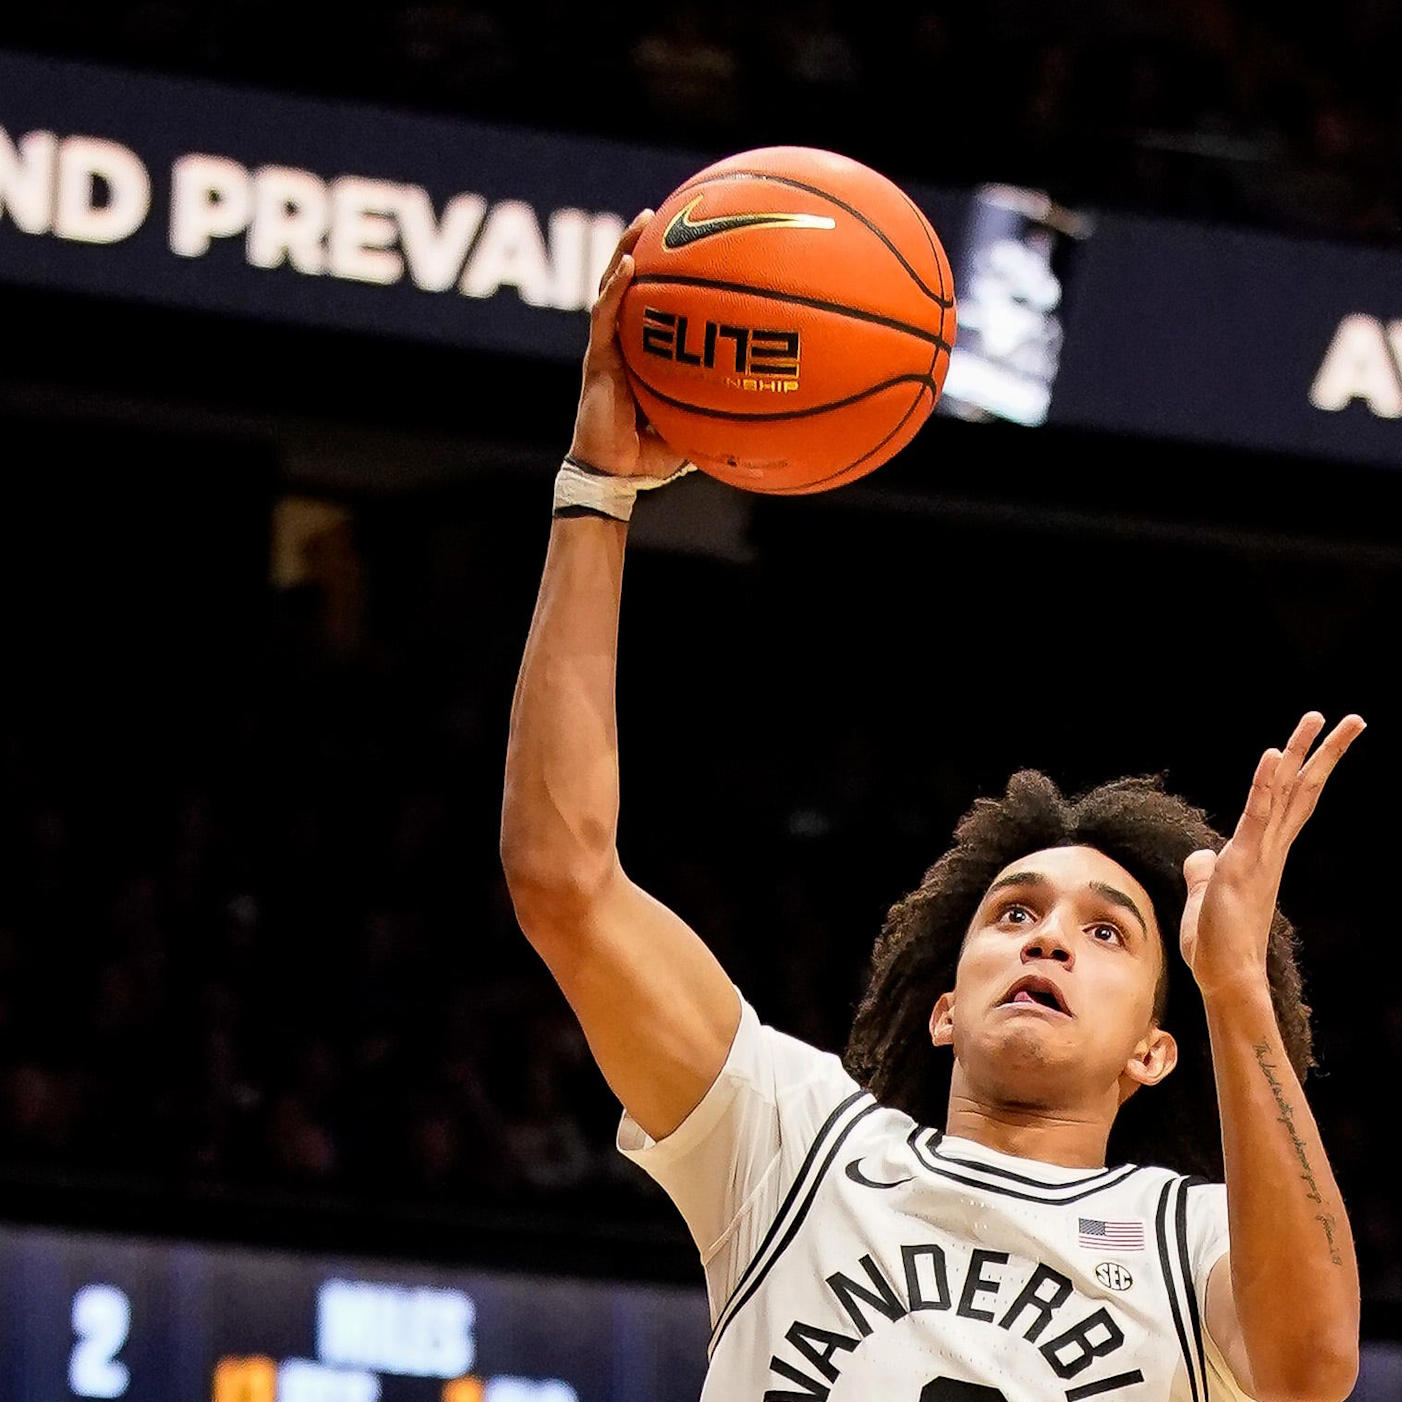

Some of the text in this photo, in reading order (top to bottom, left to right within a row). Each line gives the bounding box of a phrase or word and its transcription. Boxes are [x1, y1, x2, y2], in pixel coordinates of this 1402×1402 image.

[642, 305, 800, 378] ELITE
[1095, 1262, 1133, 1291] SEC
[69, 1283, 131, 1399] 2
